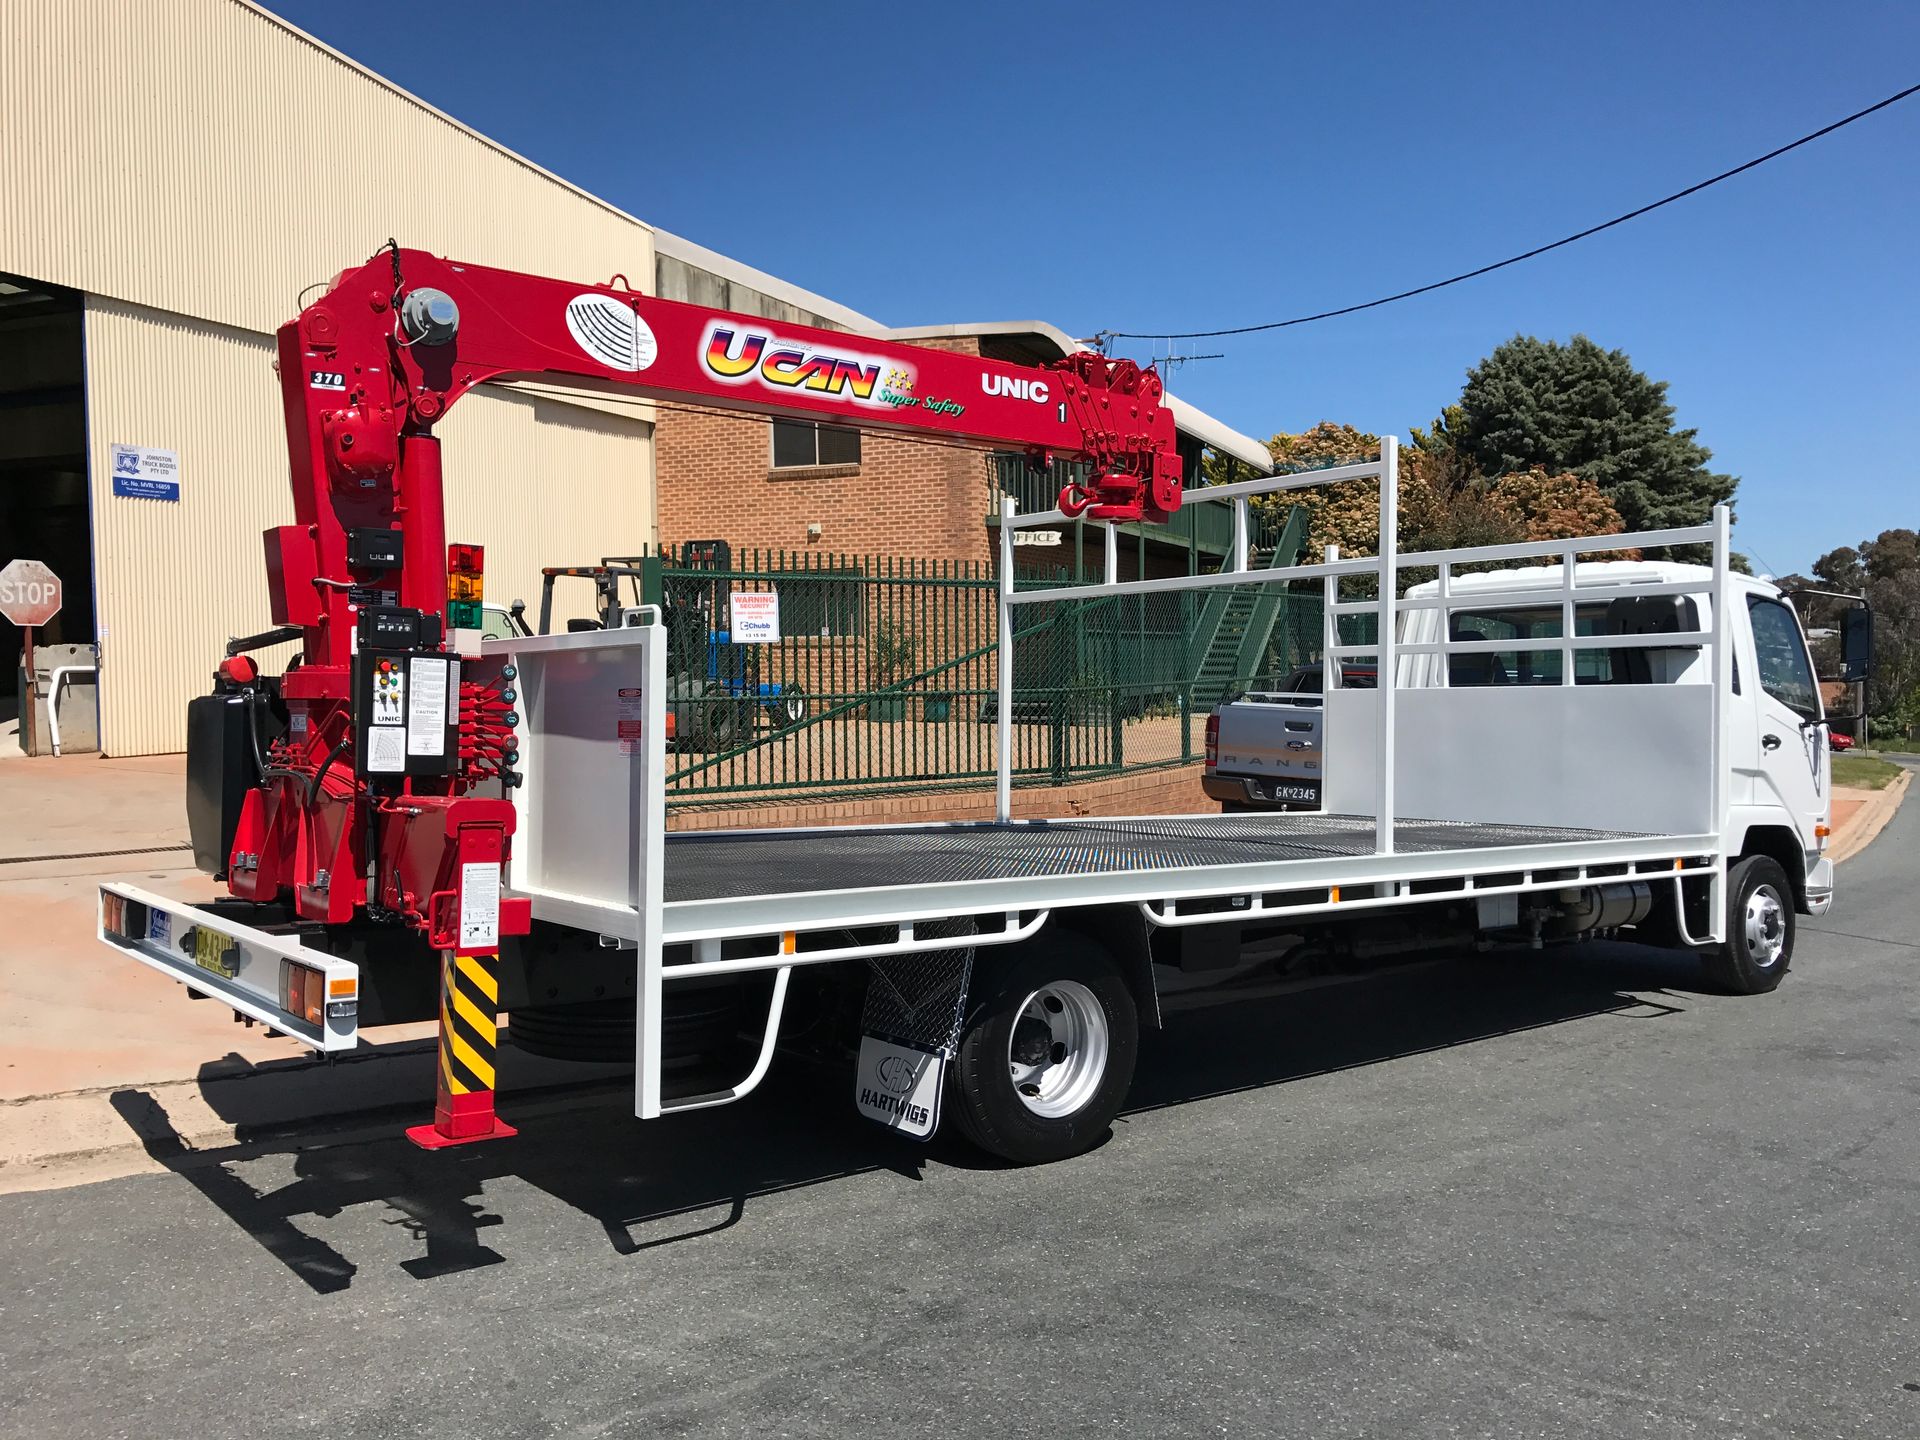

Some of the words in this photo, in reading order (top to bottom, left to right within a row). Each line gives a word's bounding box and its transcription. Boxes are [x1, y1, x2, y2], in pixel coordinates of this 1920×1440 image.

[314, 372, 343, 385] 370
[981, 372, 1049, 403] UNIC
[877, 388, 920, 407] Super
[922, 396, 965, 416] Safety
[1058, 403, 1067, 422] 1
[146, 454, 171, 462] JOHNSTON
[1014, 533, 1055, 542] FFICE
[1, 581, 57, 605] STOP
[734, 596, 775, 604] WARNING
[860, 1088, 930, 1126] HARTWIGS
